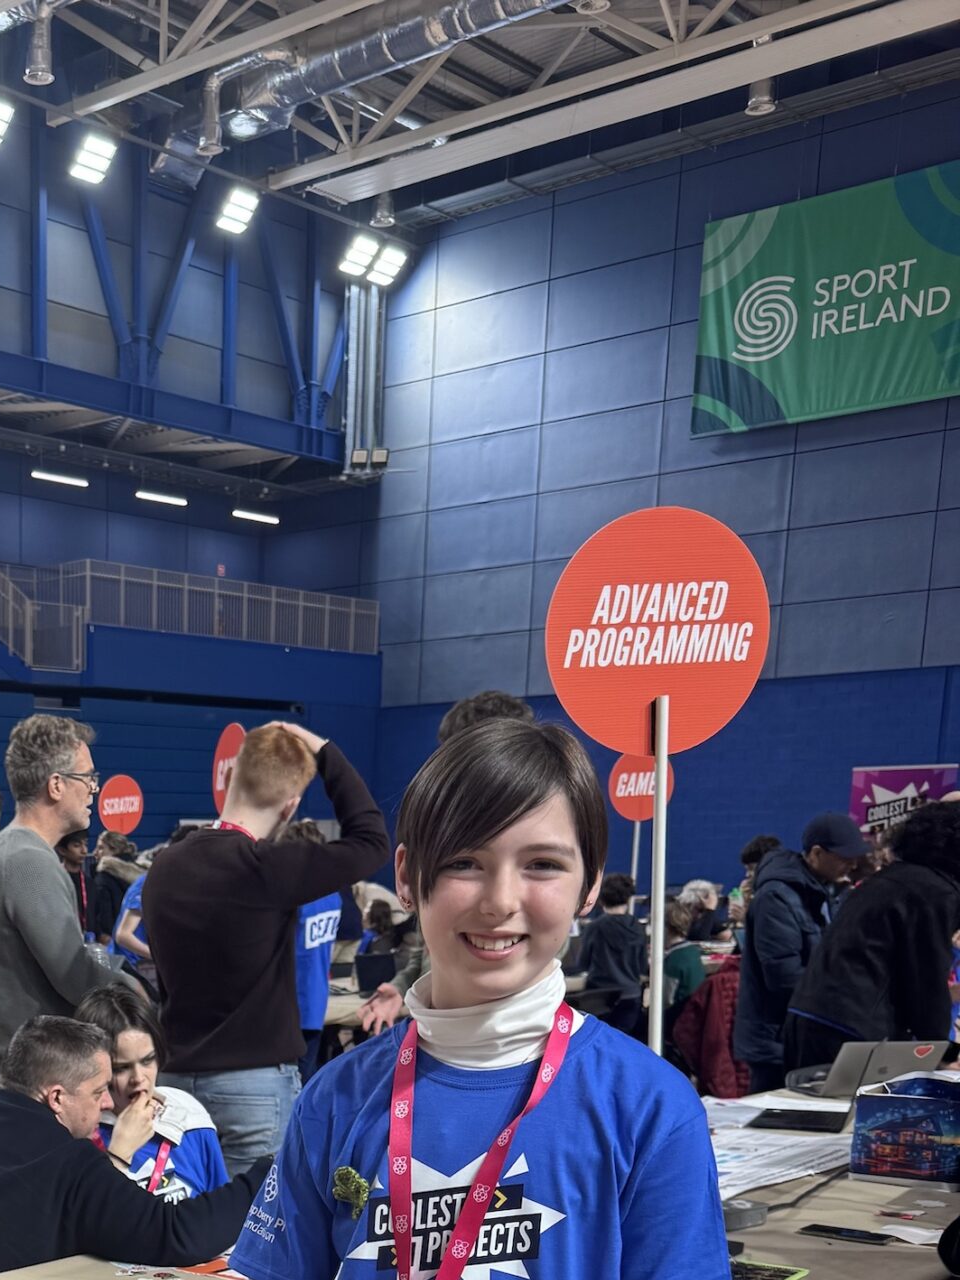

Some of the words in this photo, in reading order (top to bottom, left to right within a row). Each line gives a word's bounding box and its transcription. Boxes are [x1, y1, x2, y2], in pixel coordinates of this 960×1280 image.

[813, 258, 917, 307] SPORT
[811, 286, 951, 340] IRELAND
[591, 580, 729, 625] ADVANCED
[563, 621, 754, 669] PROGRAMMING
[103, 796, 140, 816] SCRATCH
[615, 771, 657, 799] GAME
[868, 799, 906, 822] COOLEST
